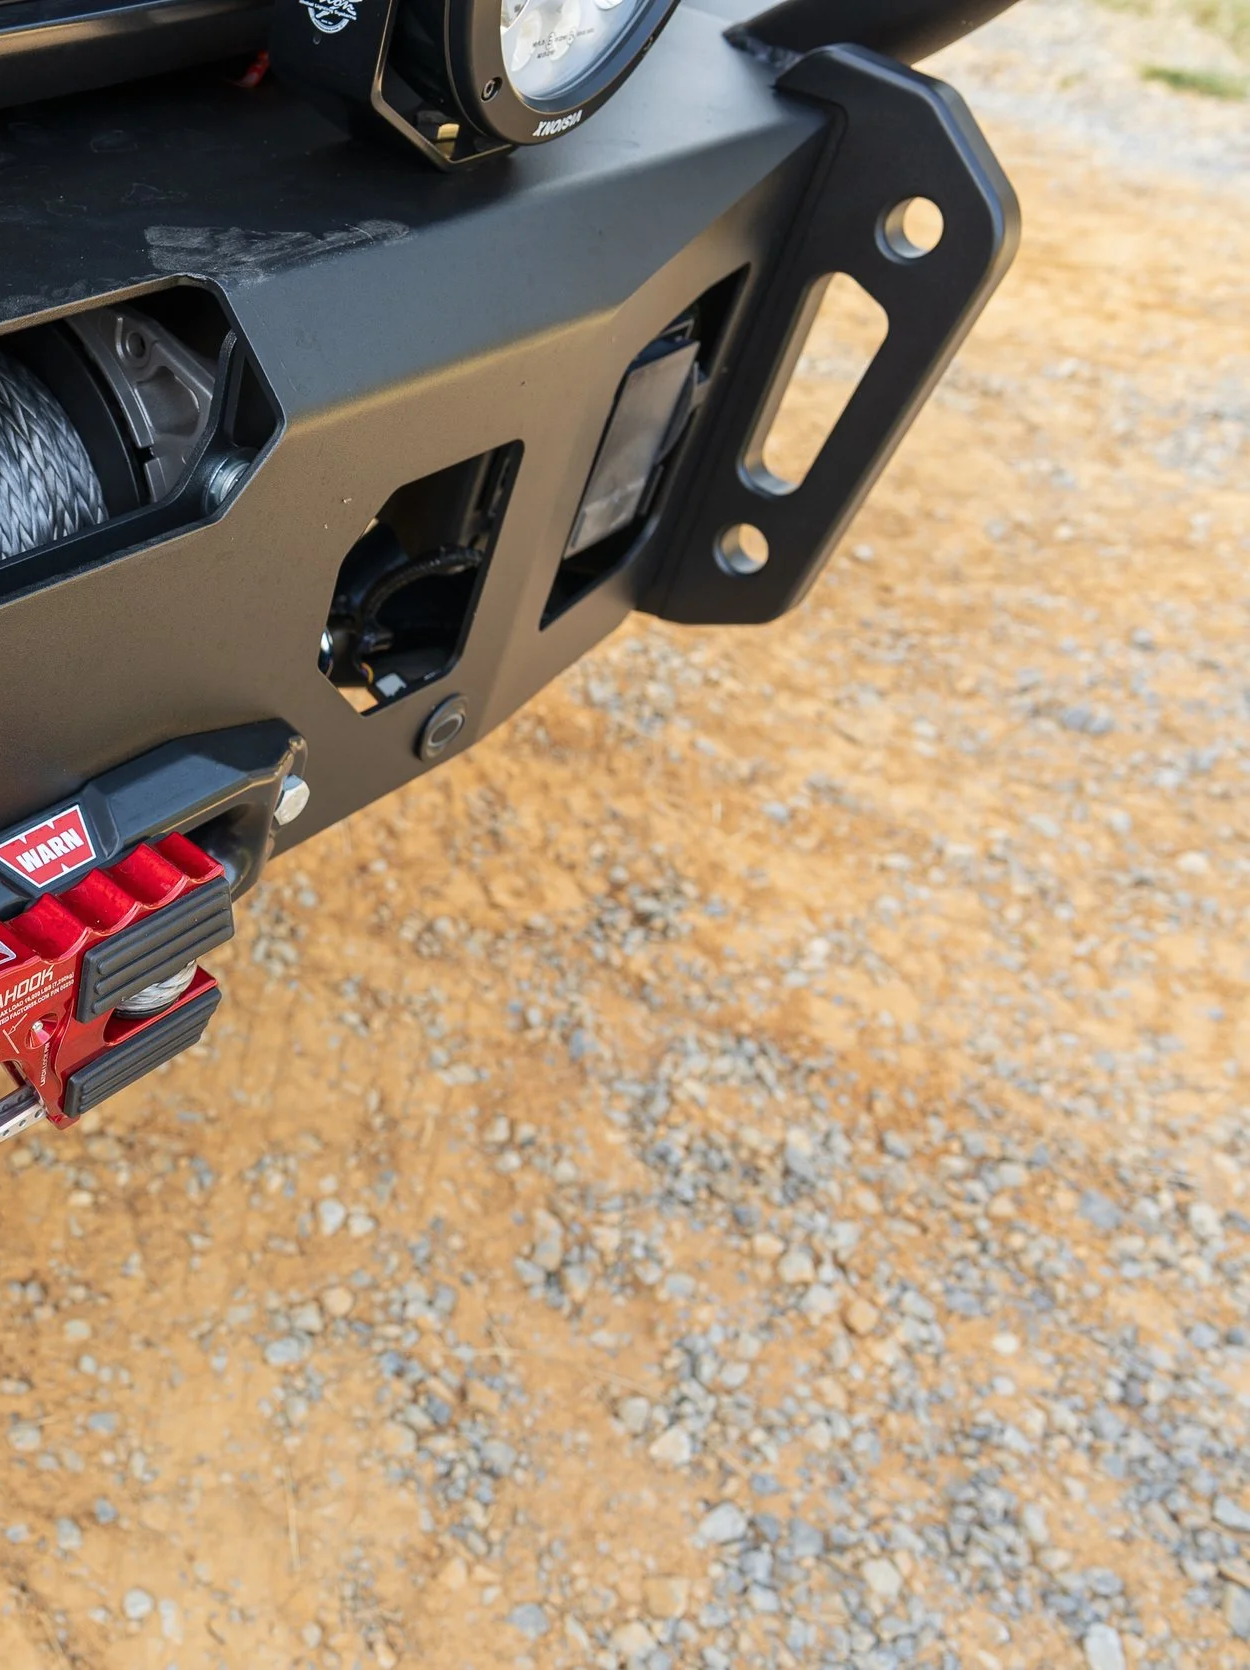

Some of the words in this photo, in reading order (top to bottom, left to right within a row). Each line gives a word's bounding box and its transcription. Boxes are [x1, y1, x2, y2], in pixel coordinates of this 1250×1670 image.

[540, 109, 583, 137] VISION
[15, 827, 85, 873] WARN
[8, 1000, 24, 1013] LOAD
